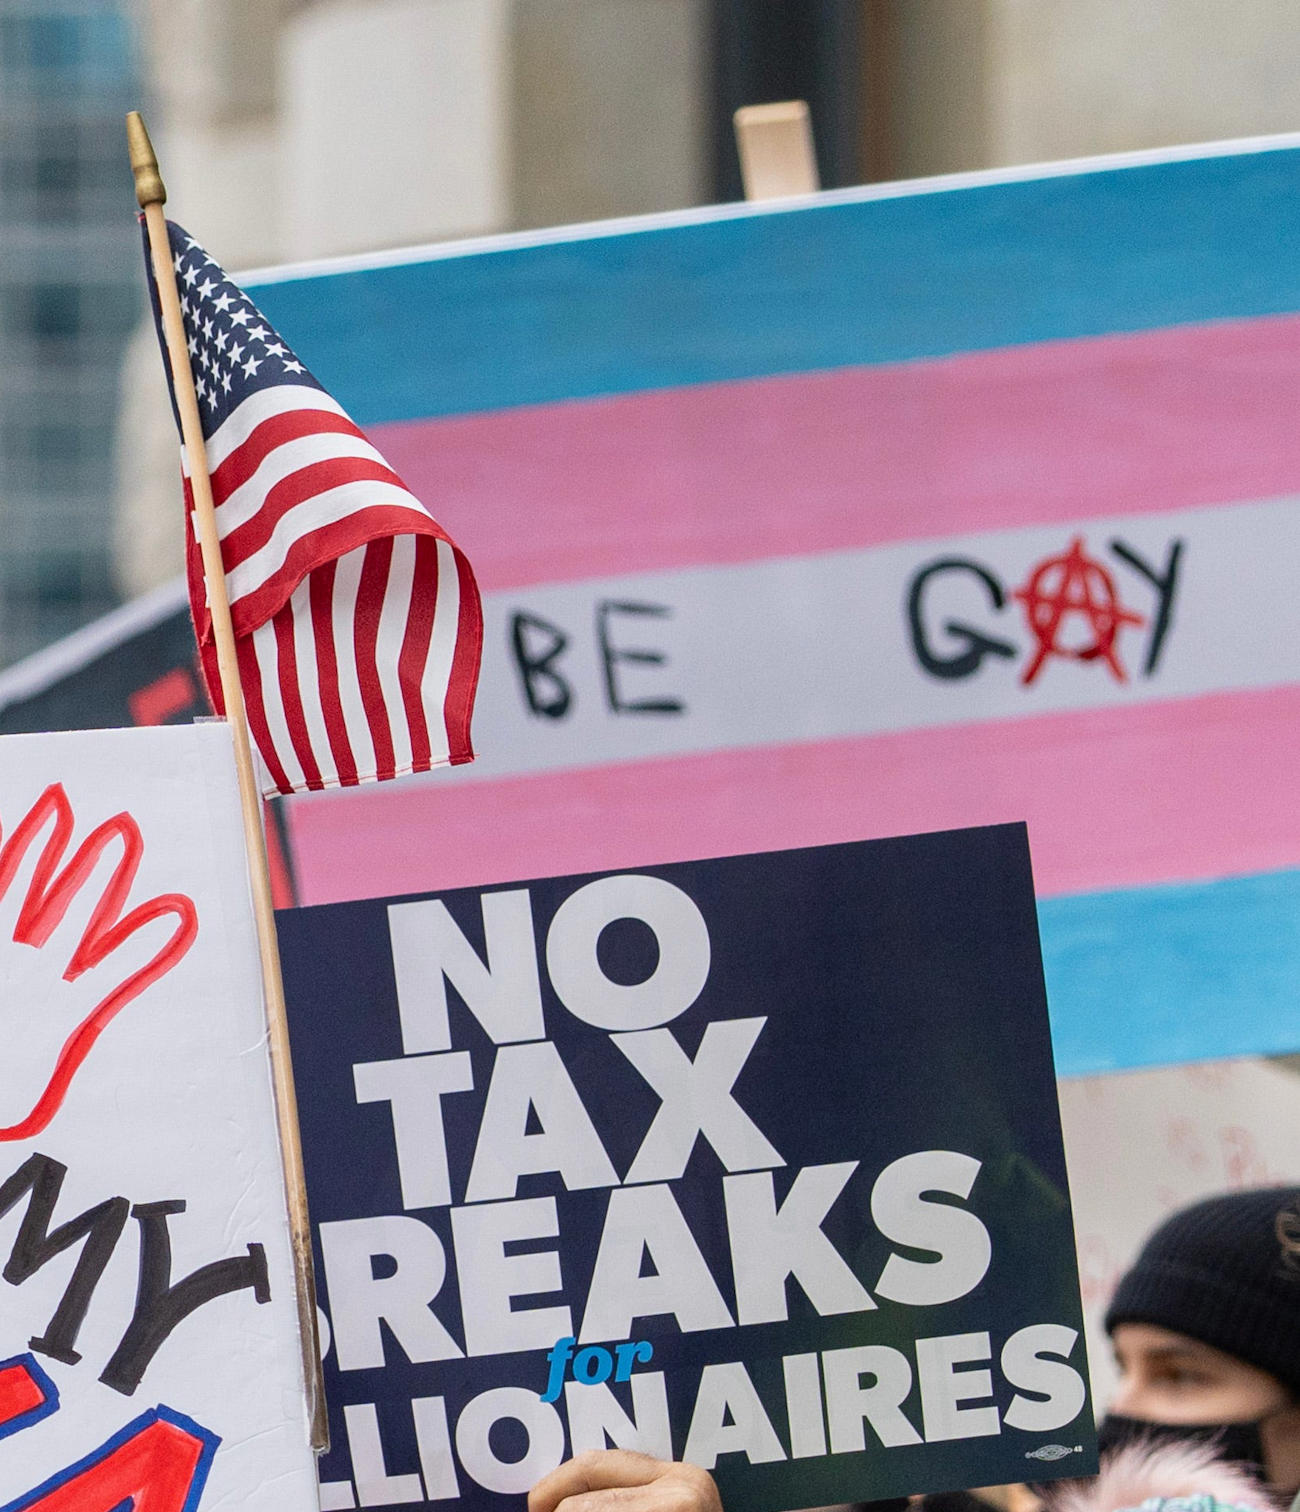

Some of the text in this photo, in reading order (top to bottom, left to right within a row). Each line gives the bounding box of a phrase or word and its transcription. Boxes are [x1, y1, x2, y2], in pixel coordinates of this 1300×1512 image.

[508, 535, 1185, 720] BE GAY
[385, 873, 712, 1056] NO
[352, 1015, 788, 1211] TAX
[316, 1149, 994, 1372] REAKS
[540, 1336, 653, 1403] for
